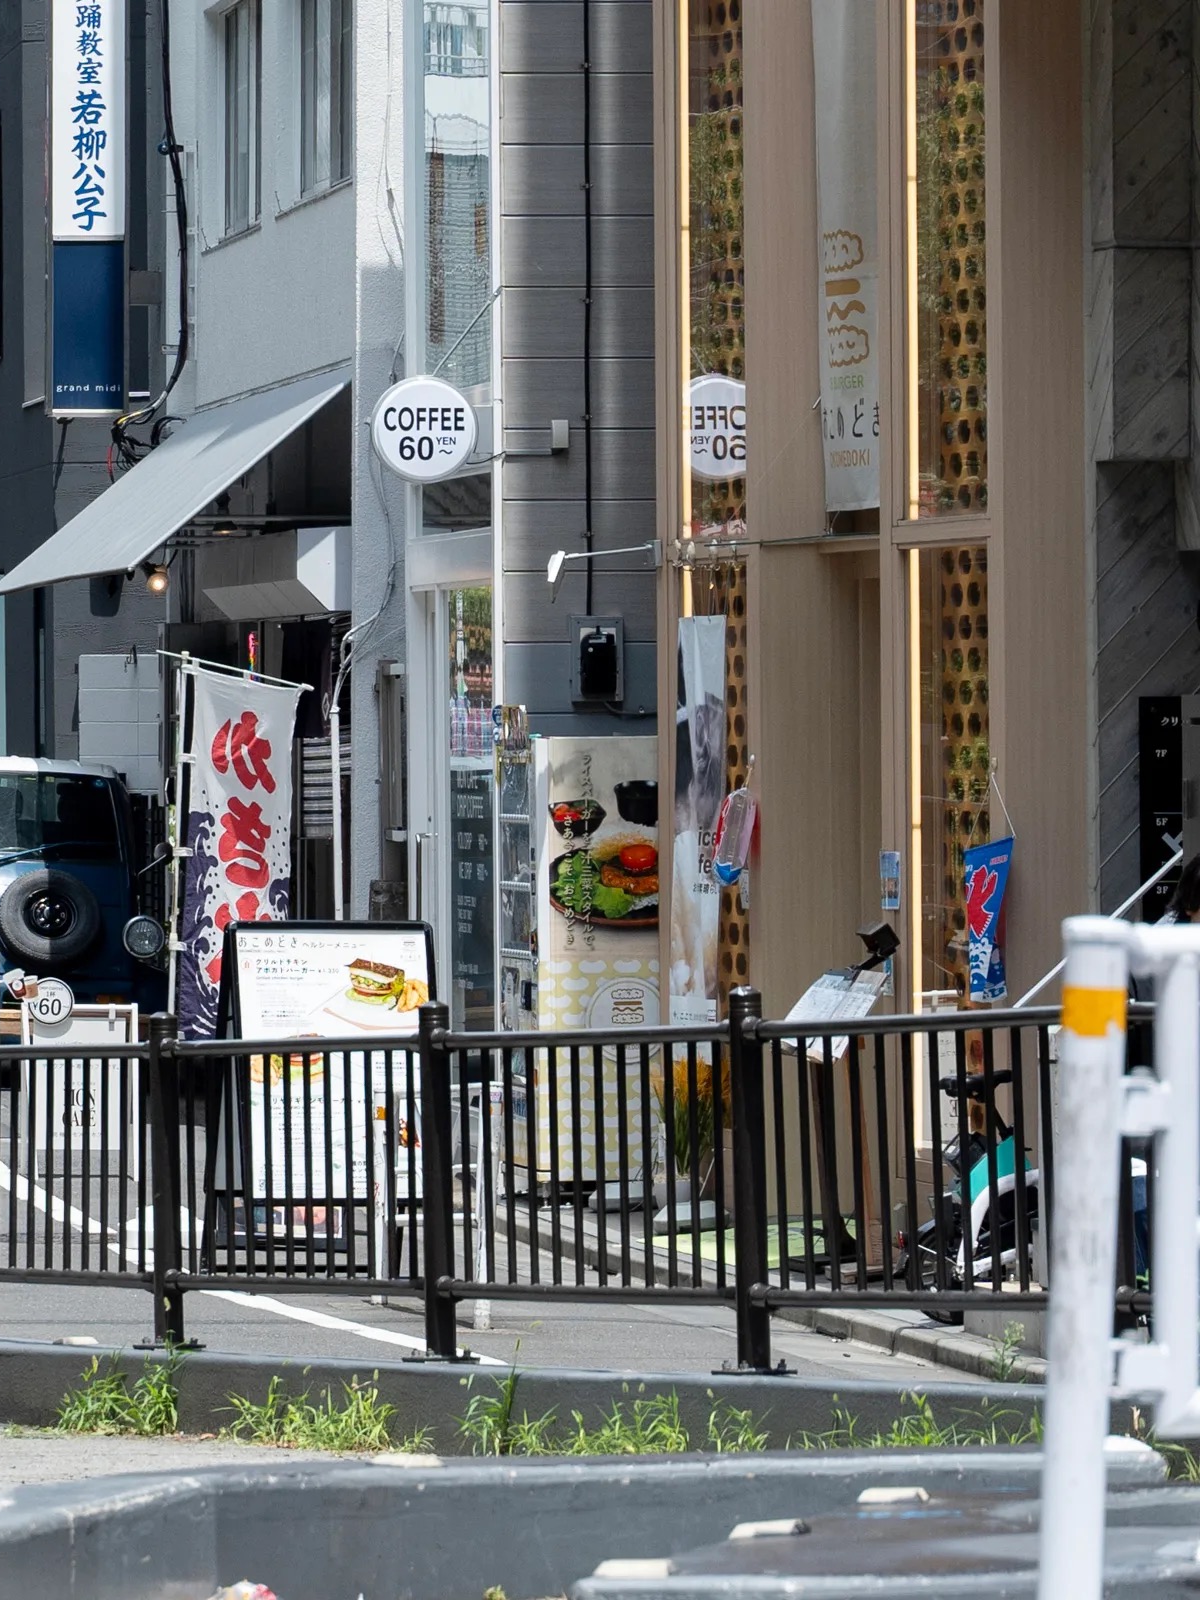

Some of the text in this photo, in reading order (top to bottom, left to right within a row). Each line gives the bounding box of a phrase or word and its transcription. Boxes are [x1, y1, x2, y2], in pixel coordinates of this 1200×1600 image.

[70, 0, 108, 231] 踊教室若柳公子
[56, 382, 122, 393] grand midi
[383, 406, 466, 431] COFFEE
[398, 436, 457, 461] 60 YEN
[1155, 749, 1168, 758] 7F
[1155, 817, 1169, 827] 5F
[1156, 886, 1169, 895] 3F
[238, 934, 298, 949] おこめどき
